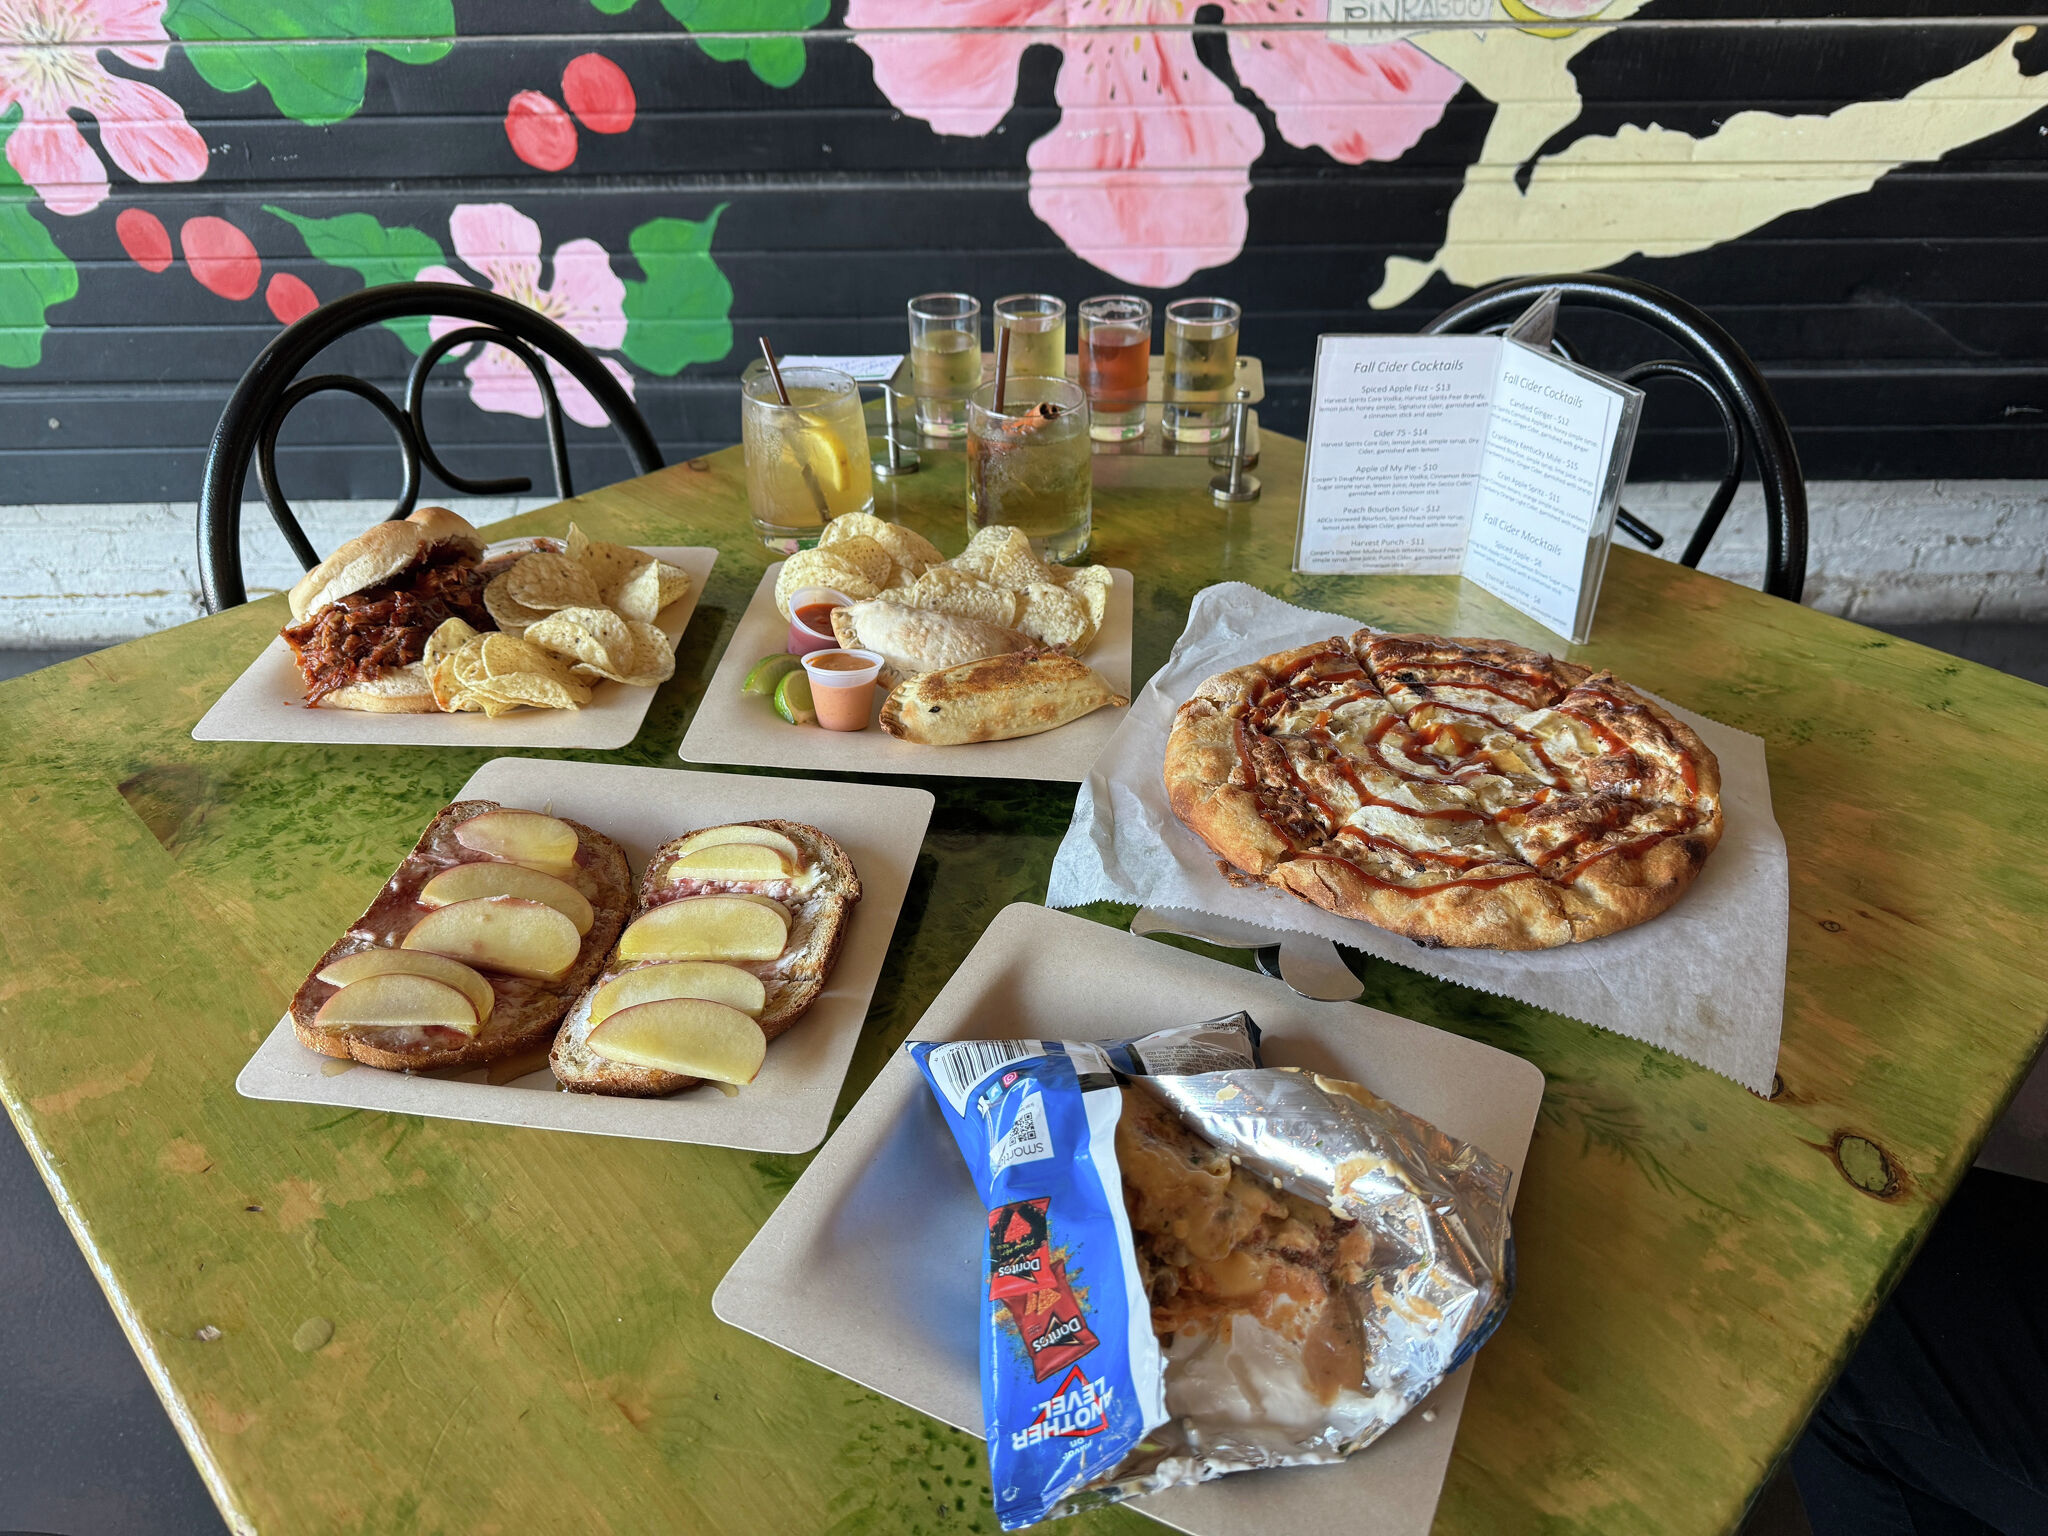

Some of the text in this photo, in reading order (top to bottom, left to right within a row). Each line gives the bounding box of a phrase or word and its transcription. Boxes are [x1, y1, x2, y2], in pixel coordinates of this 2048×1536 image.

[1354, 360, 1464, 373] Fall Cider Cocktails
[1362, 385, 1387, 393] Spiced
[1389, 385, 1412, 393] Apple
[1436, 383, 1451, 391] $13
[1503, 372, 1584, 408] Fall Cider Cocktails
[1510, 399, 1533, 413] Candied
[1534, 407, 1554, 421] Ginger
[1558, 415, 1571, 426] $12
[1413, 428, 1427, 436] $14
[1492, 431, 1520, 448] Cranberry
[1520, 440, 1547, 458] Kentucky
[1547, 451, 1563, 463] Mule
[1566, 459, 1580, 470] $15
[1380, 464, 1389, 472] of
[1390, 465, 1402, 473] My
[1423, 463, 1438, 471] $10
[1483, 513, 1563, 556] Fall Cider Mocktails
[998, 1256, 1040, 1278] Doritos
[1032, 1316, 1082, 1353] Doritos
[1011, 1385, 1114, 1451] ANOTHER
